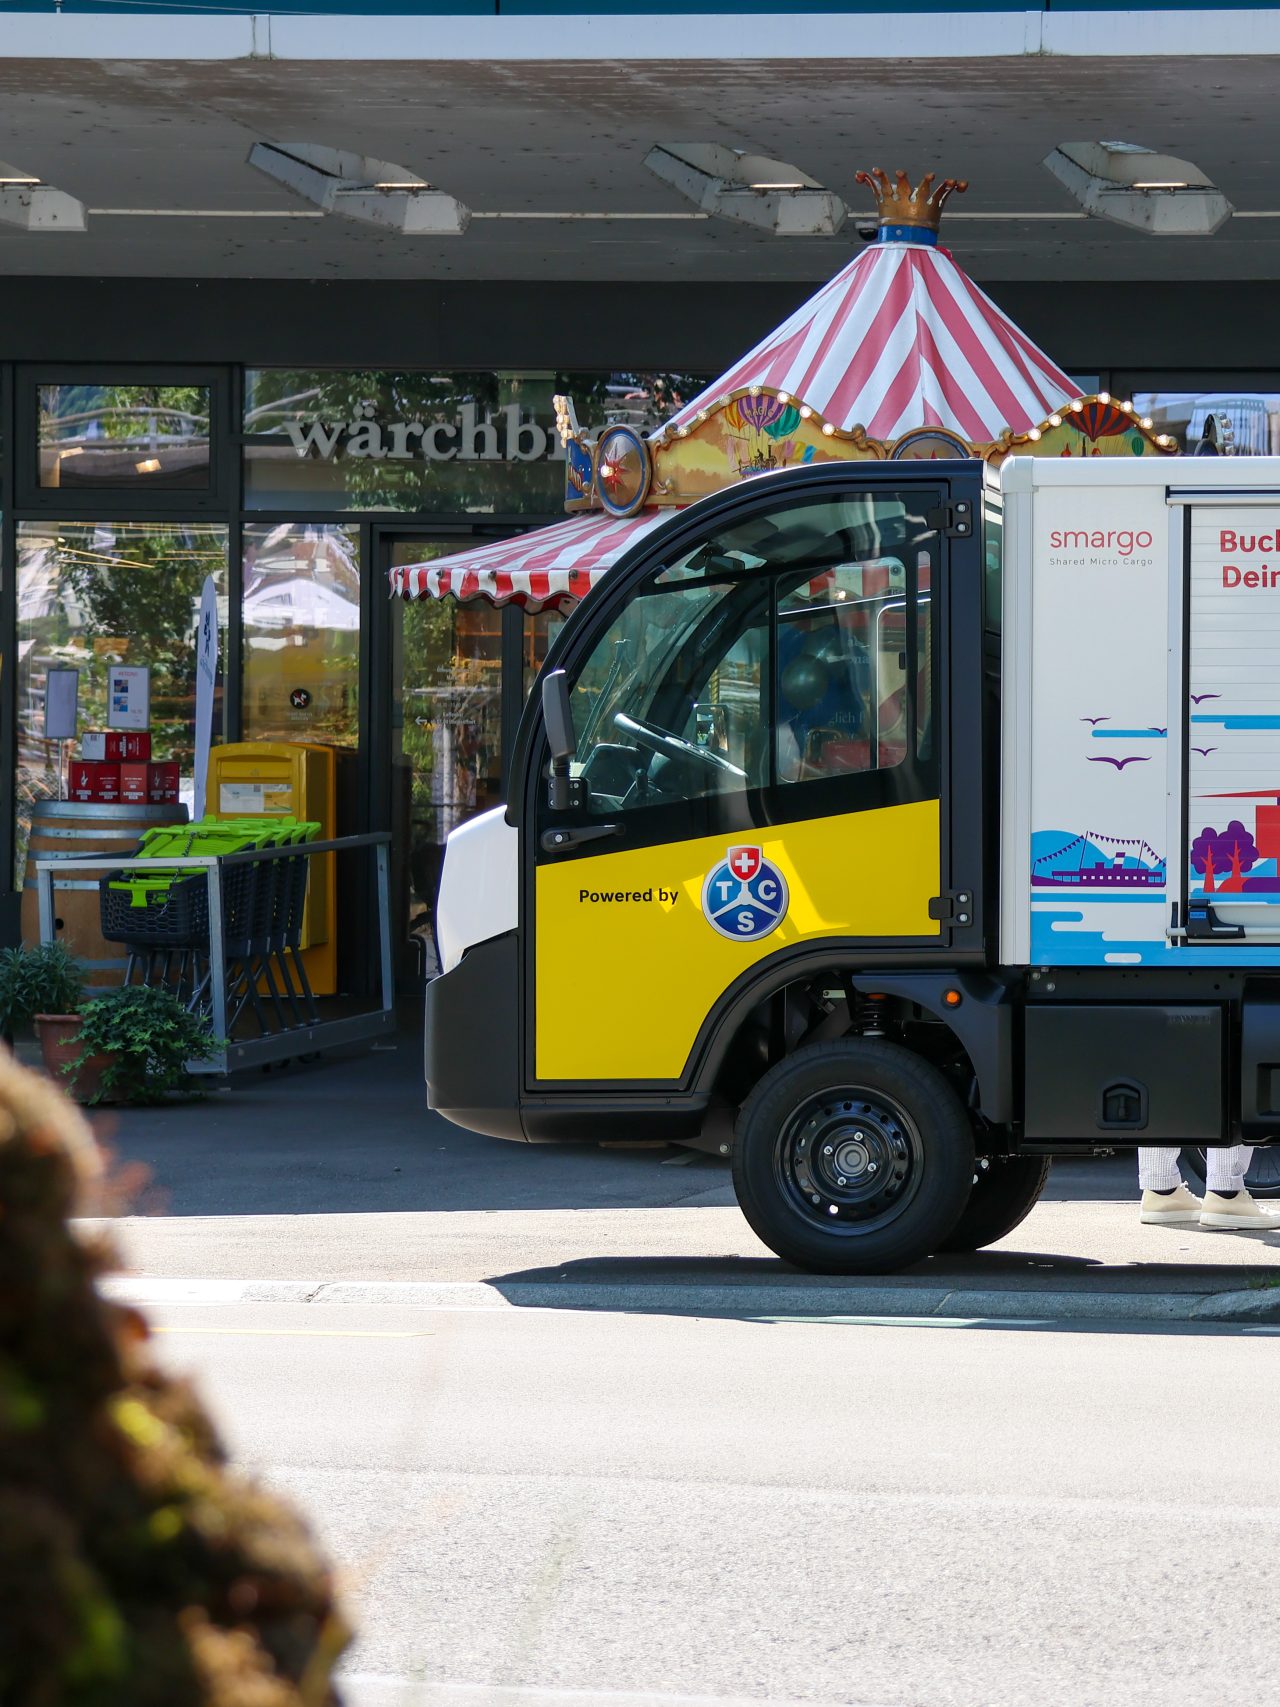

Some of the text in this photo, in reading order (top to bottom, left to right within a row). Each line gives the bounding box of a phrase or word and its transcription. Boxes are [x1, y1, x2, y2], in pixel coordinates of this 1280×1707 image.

[282, 402, 652, 461] wärchb
[1050, 530, 1153, 556] smargo
[1123, 558, 1153, 567] Cargo
[579, 888, 679, 904] Powered by
